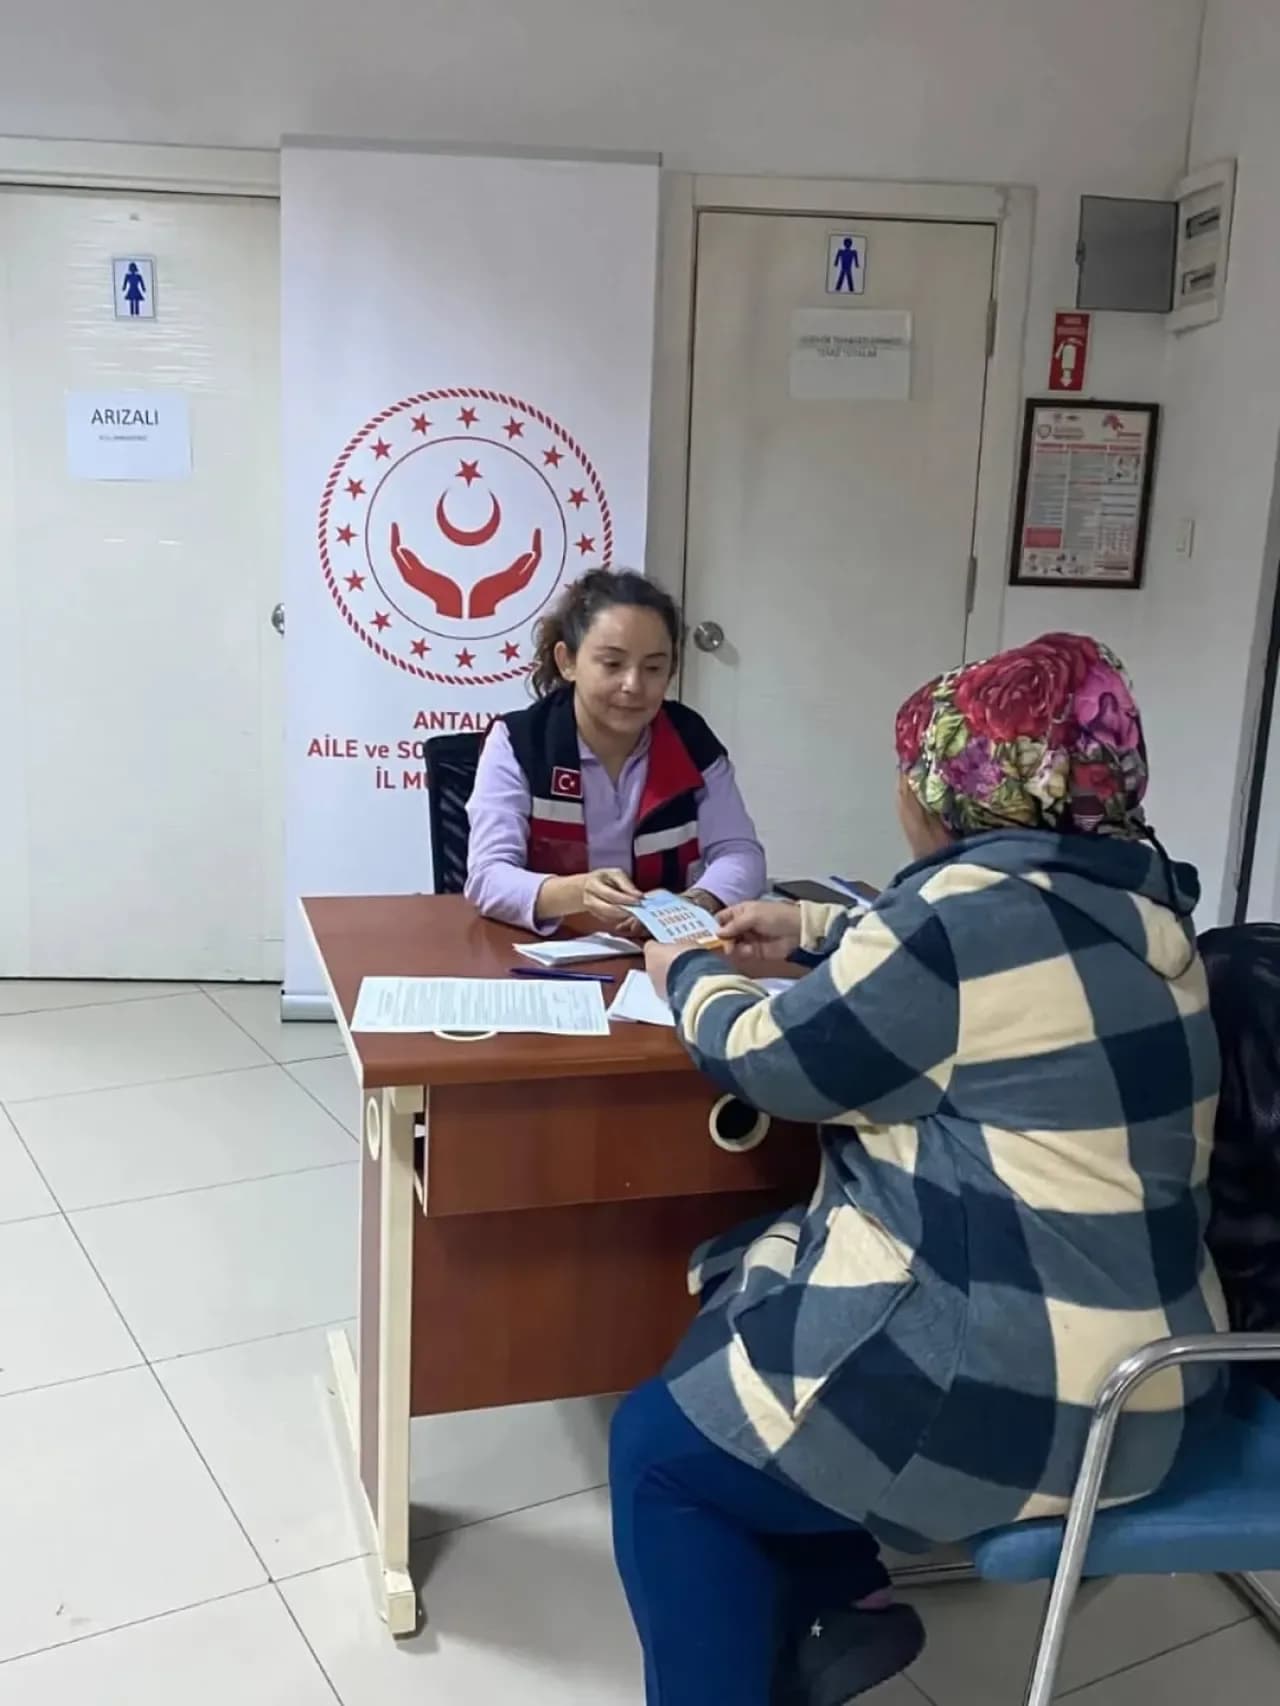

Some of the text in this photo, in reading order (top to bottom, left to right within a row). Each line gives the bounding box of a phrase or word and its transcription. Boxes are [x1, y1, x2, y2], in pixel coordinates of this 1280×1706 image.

[91, 408, 159, 425] ARIZALI
[413, 710, 498, 731] ANTALY
[307, 733, 425, 759] AİLE ve SO
[376, 765, 396, 789] İL
